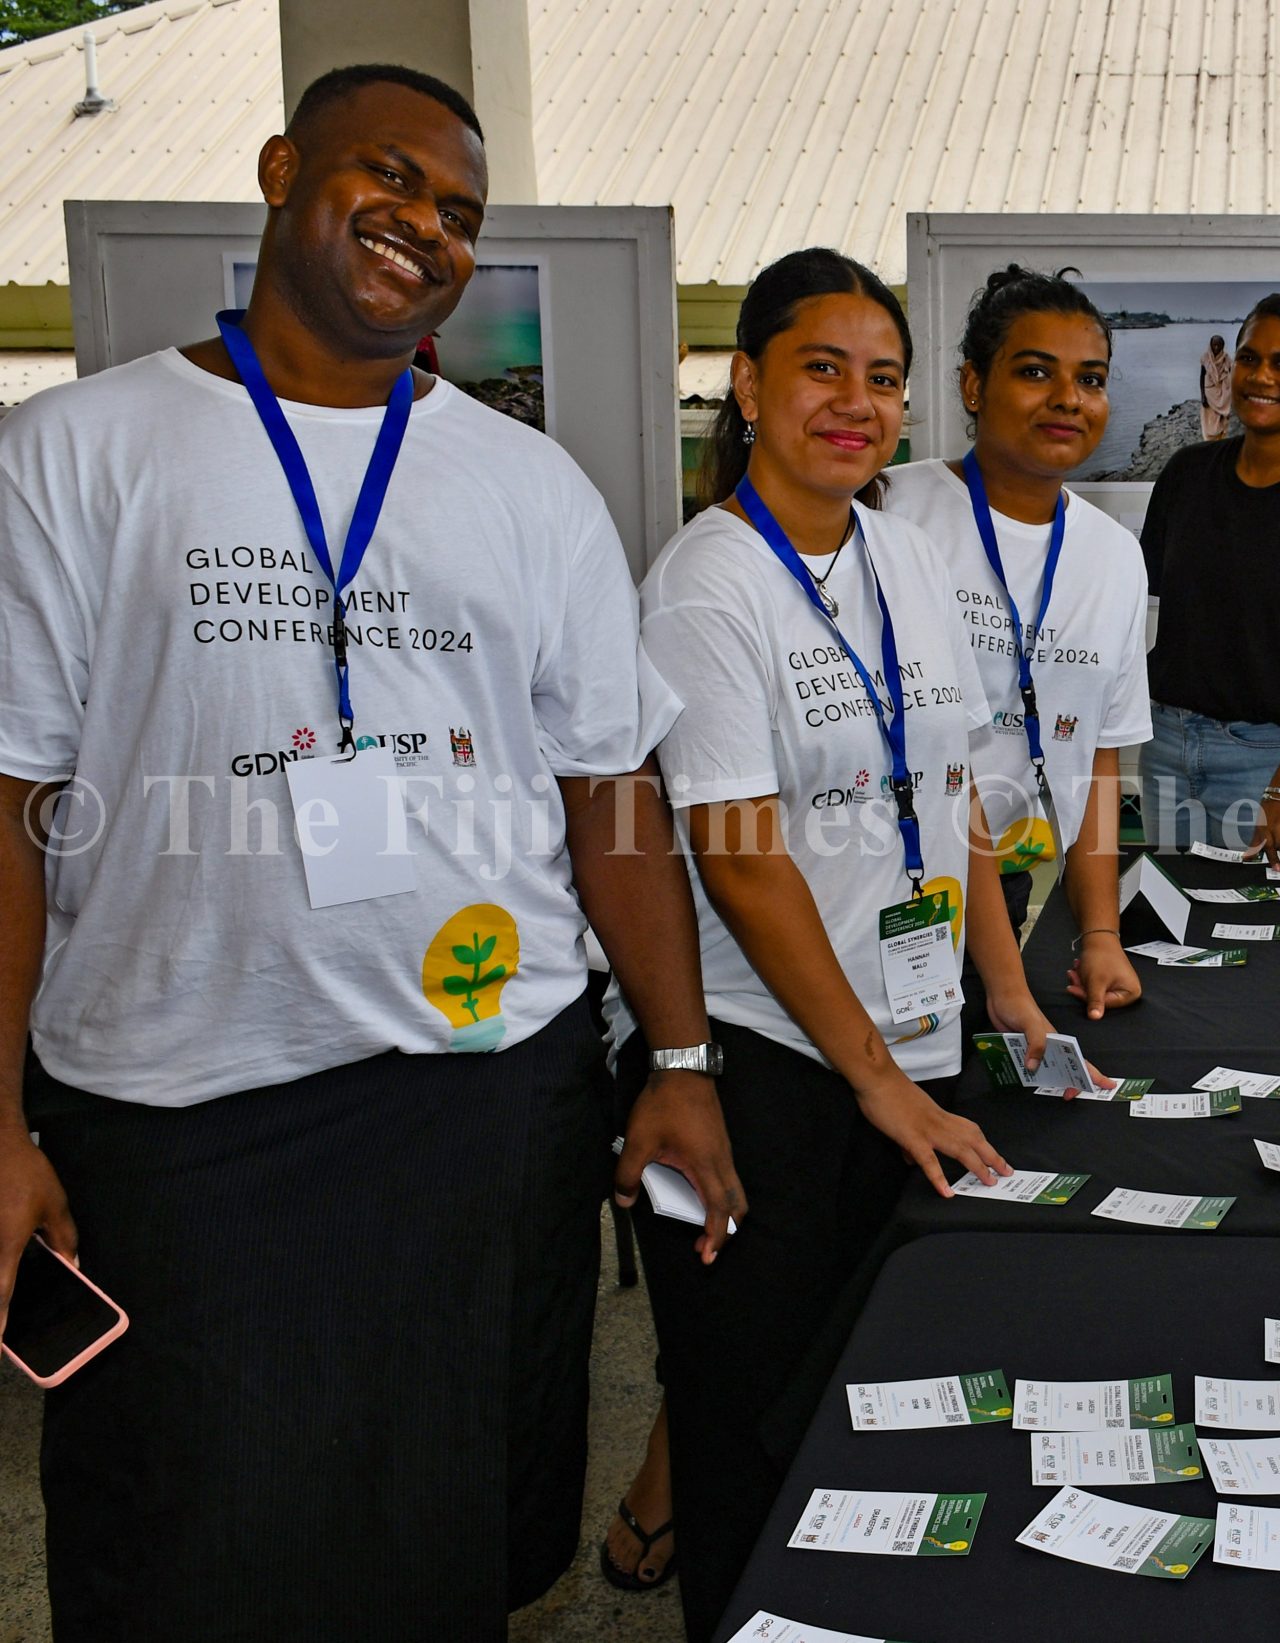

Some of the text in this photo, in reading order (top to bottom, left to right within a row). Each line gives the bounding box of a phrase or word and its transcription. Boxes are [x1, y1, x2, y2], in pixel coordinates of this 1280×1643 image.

[186, 546, 313, 574] GLOBAL
[956, 589, 1004, 610] OBAL
[408, 627, 474, 653] 2024
[788, 646, 850, 670] GLOBA
[1054, 648, 1100, 665] 2024
[795, 661, 924, 700] DEVELOMNT
[1002, 713, 1025, 728] US
[887, 931, 933, 949] GLOBAL SYNERGIES
[907, 951, 930, 963] HANNAH
[911, 961, 927, 971] MALO
